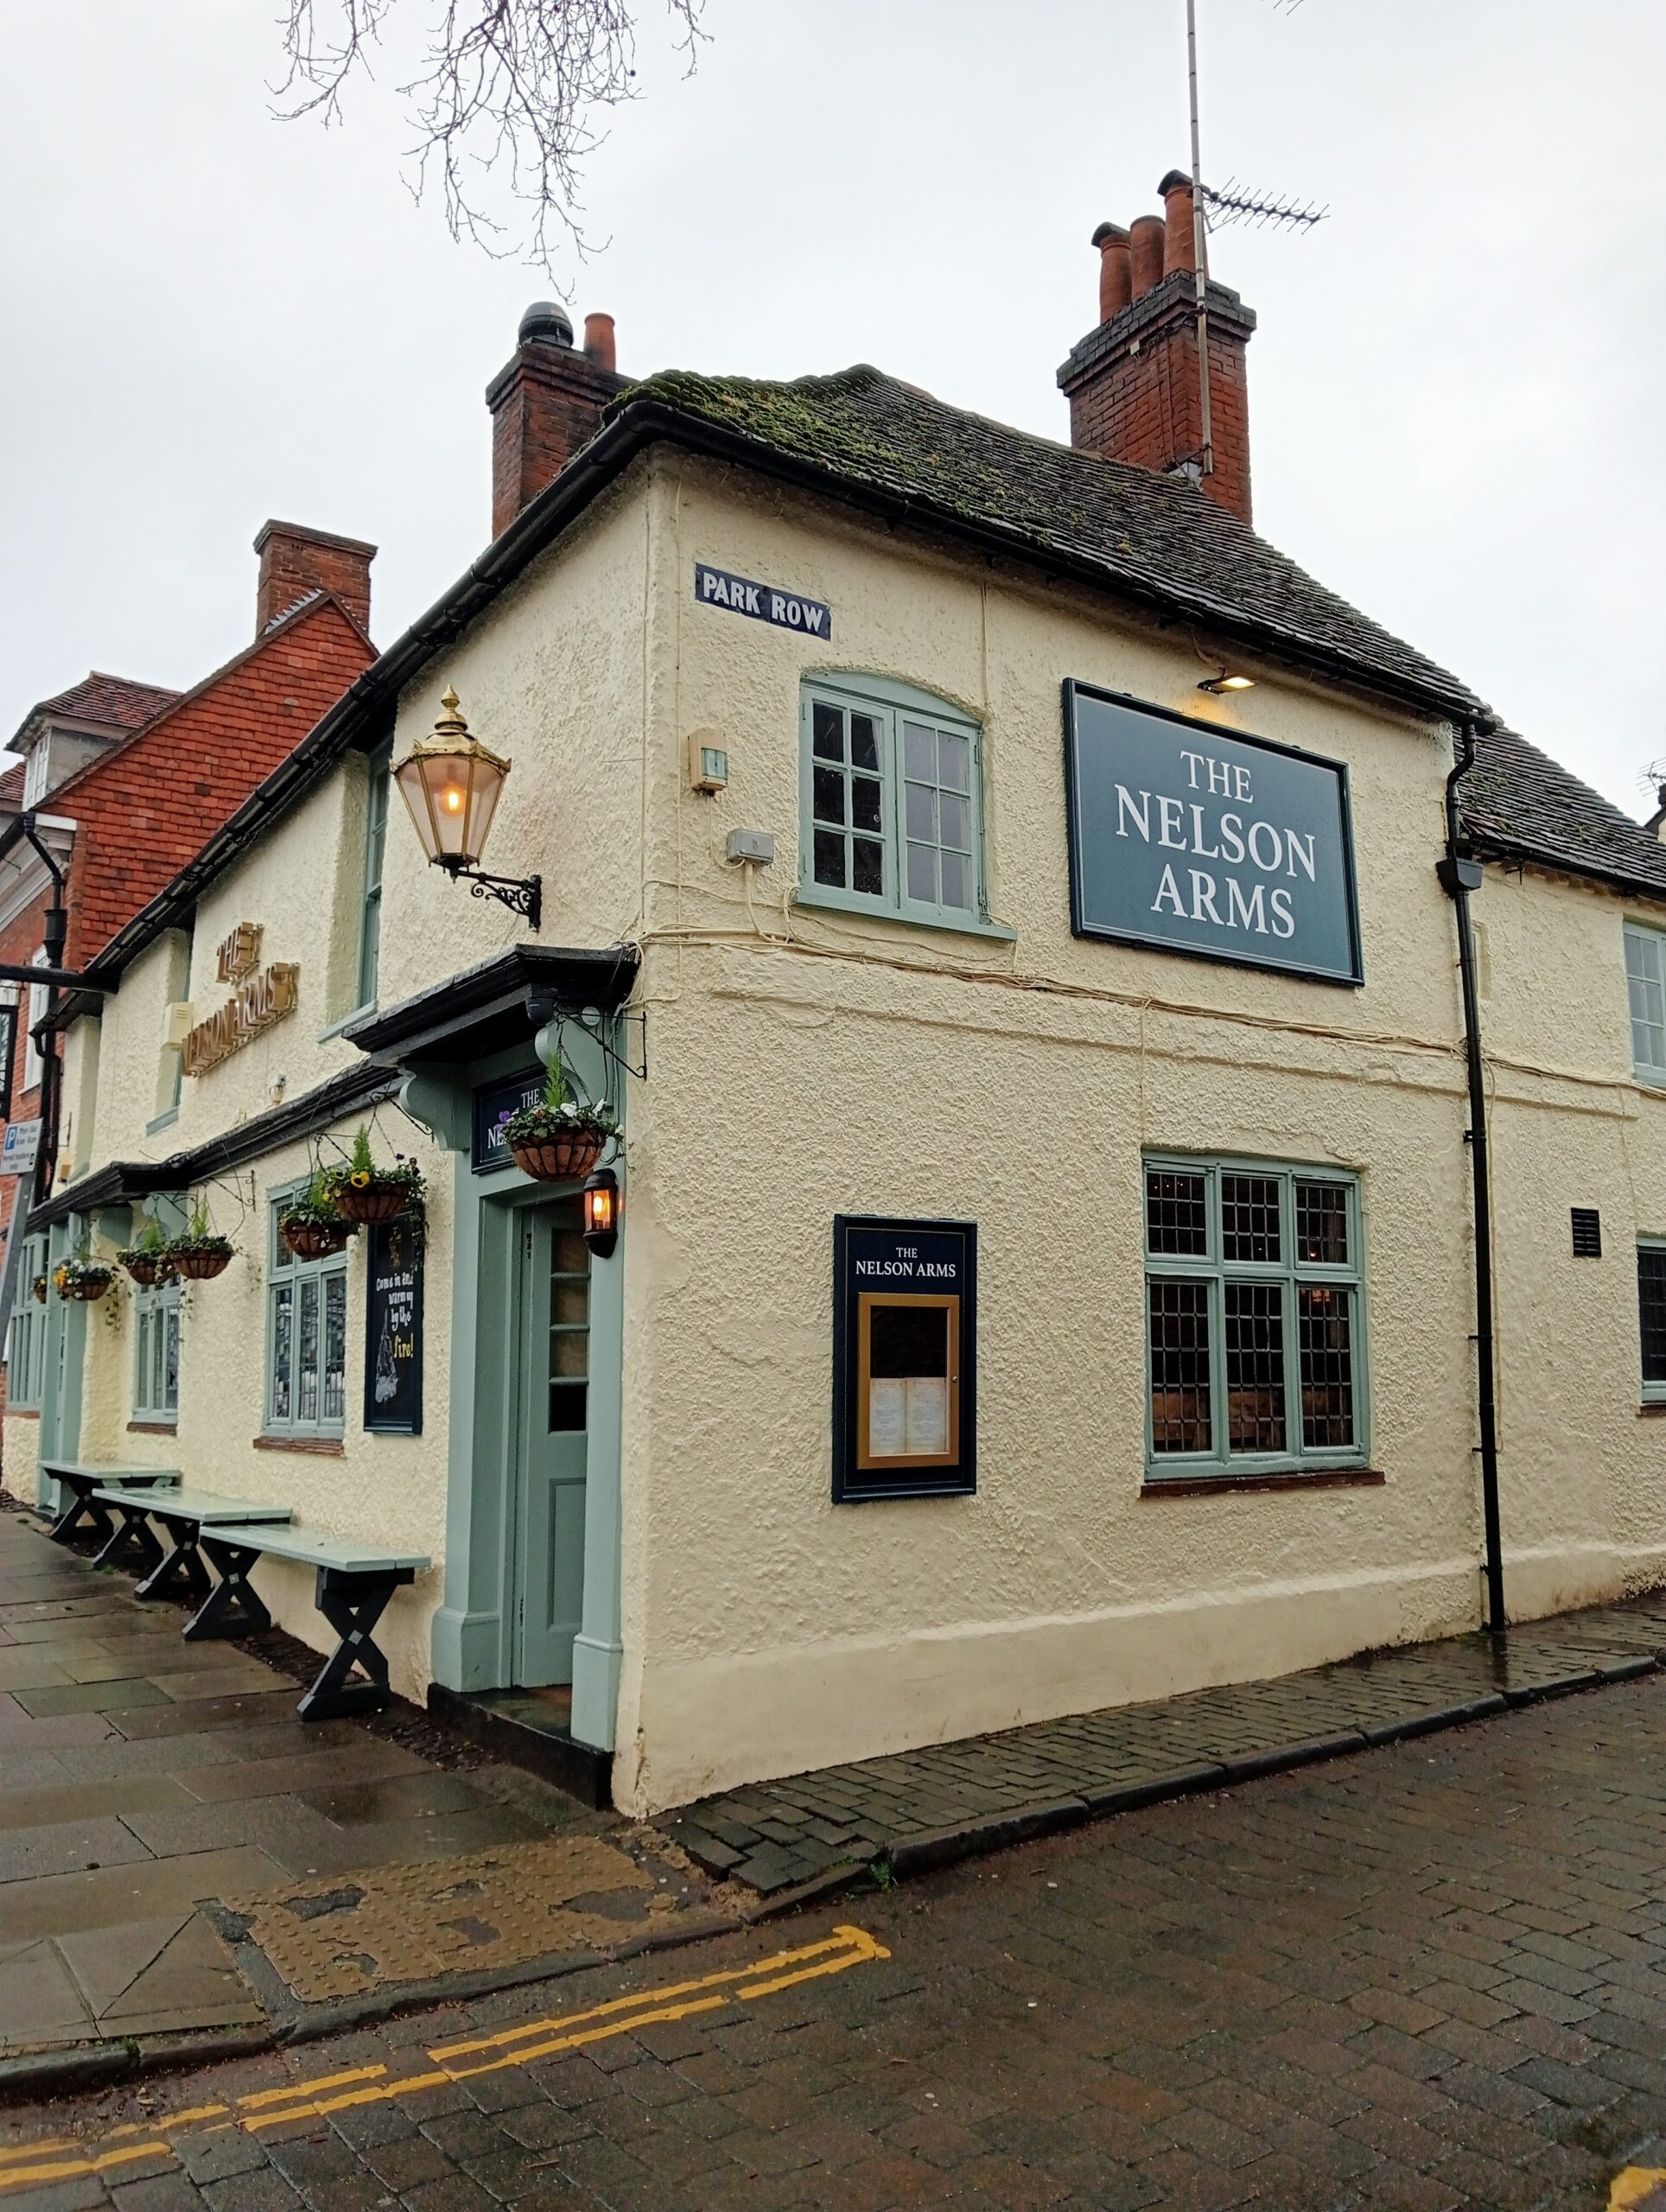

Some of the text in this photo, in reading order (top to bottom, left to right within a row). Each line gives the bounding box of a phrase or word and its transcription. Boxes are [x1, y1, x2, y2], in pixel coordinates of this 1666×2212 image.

[703, 571, 823, 632] PARK ROW
[1180, 750, 1254, 804] THE
[1114, 783, 1316, 883] NELSON
[1149, 862, 1295, 939] ARMS
[216, 922, 254, 983] THE
[235, 962, 290, 1032] ARMS
[520, 1089, 540, 1109] THE
[895, 1247, 918, 1259] THE
[394, 1272, 401, 1287] in
[855, 1261, 957, 1278] NELSON ARMS
[389, 1292, 413, 1309] warm up
[391, 1306, 411, 1332] by the
[394, 1332, 413, 1358] fire!
